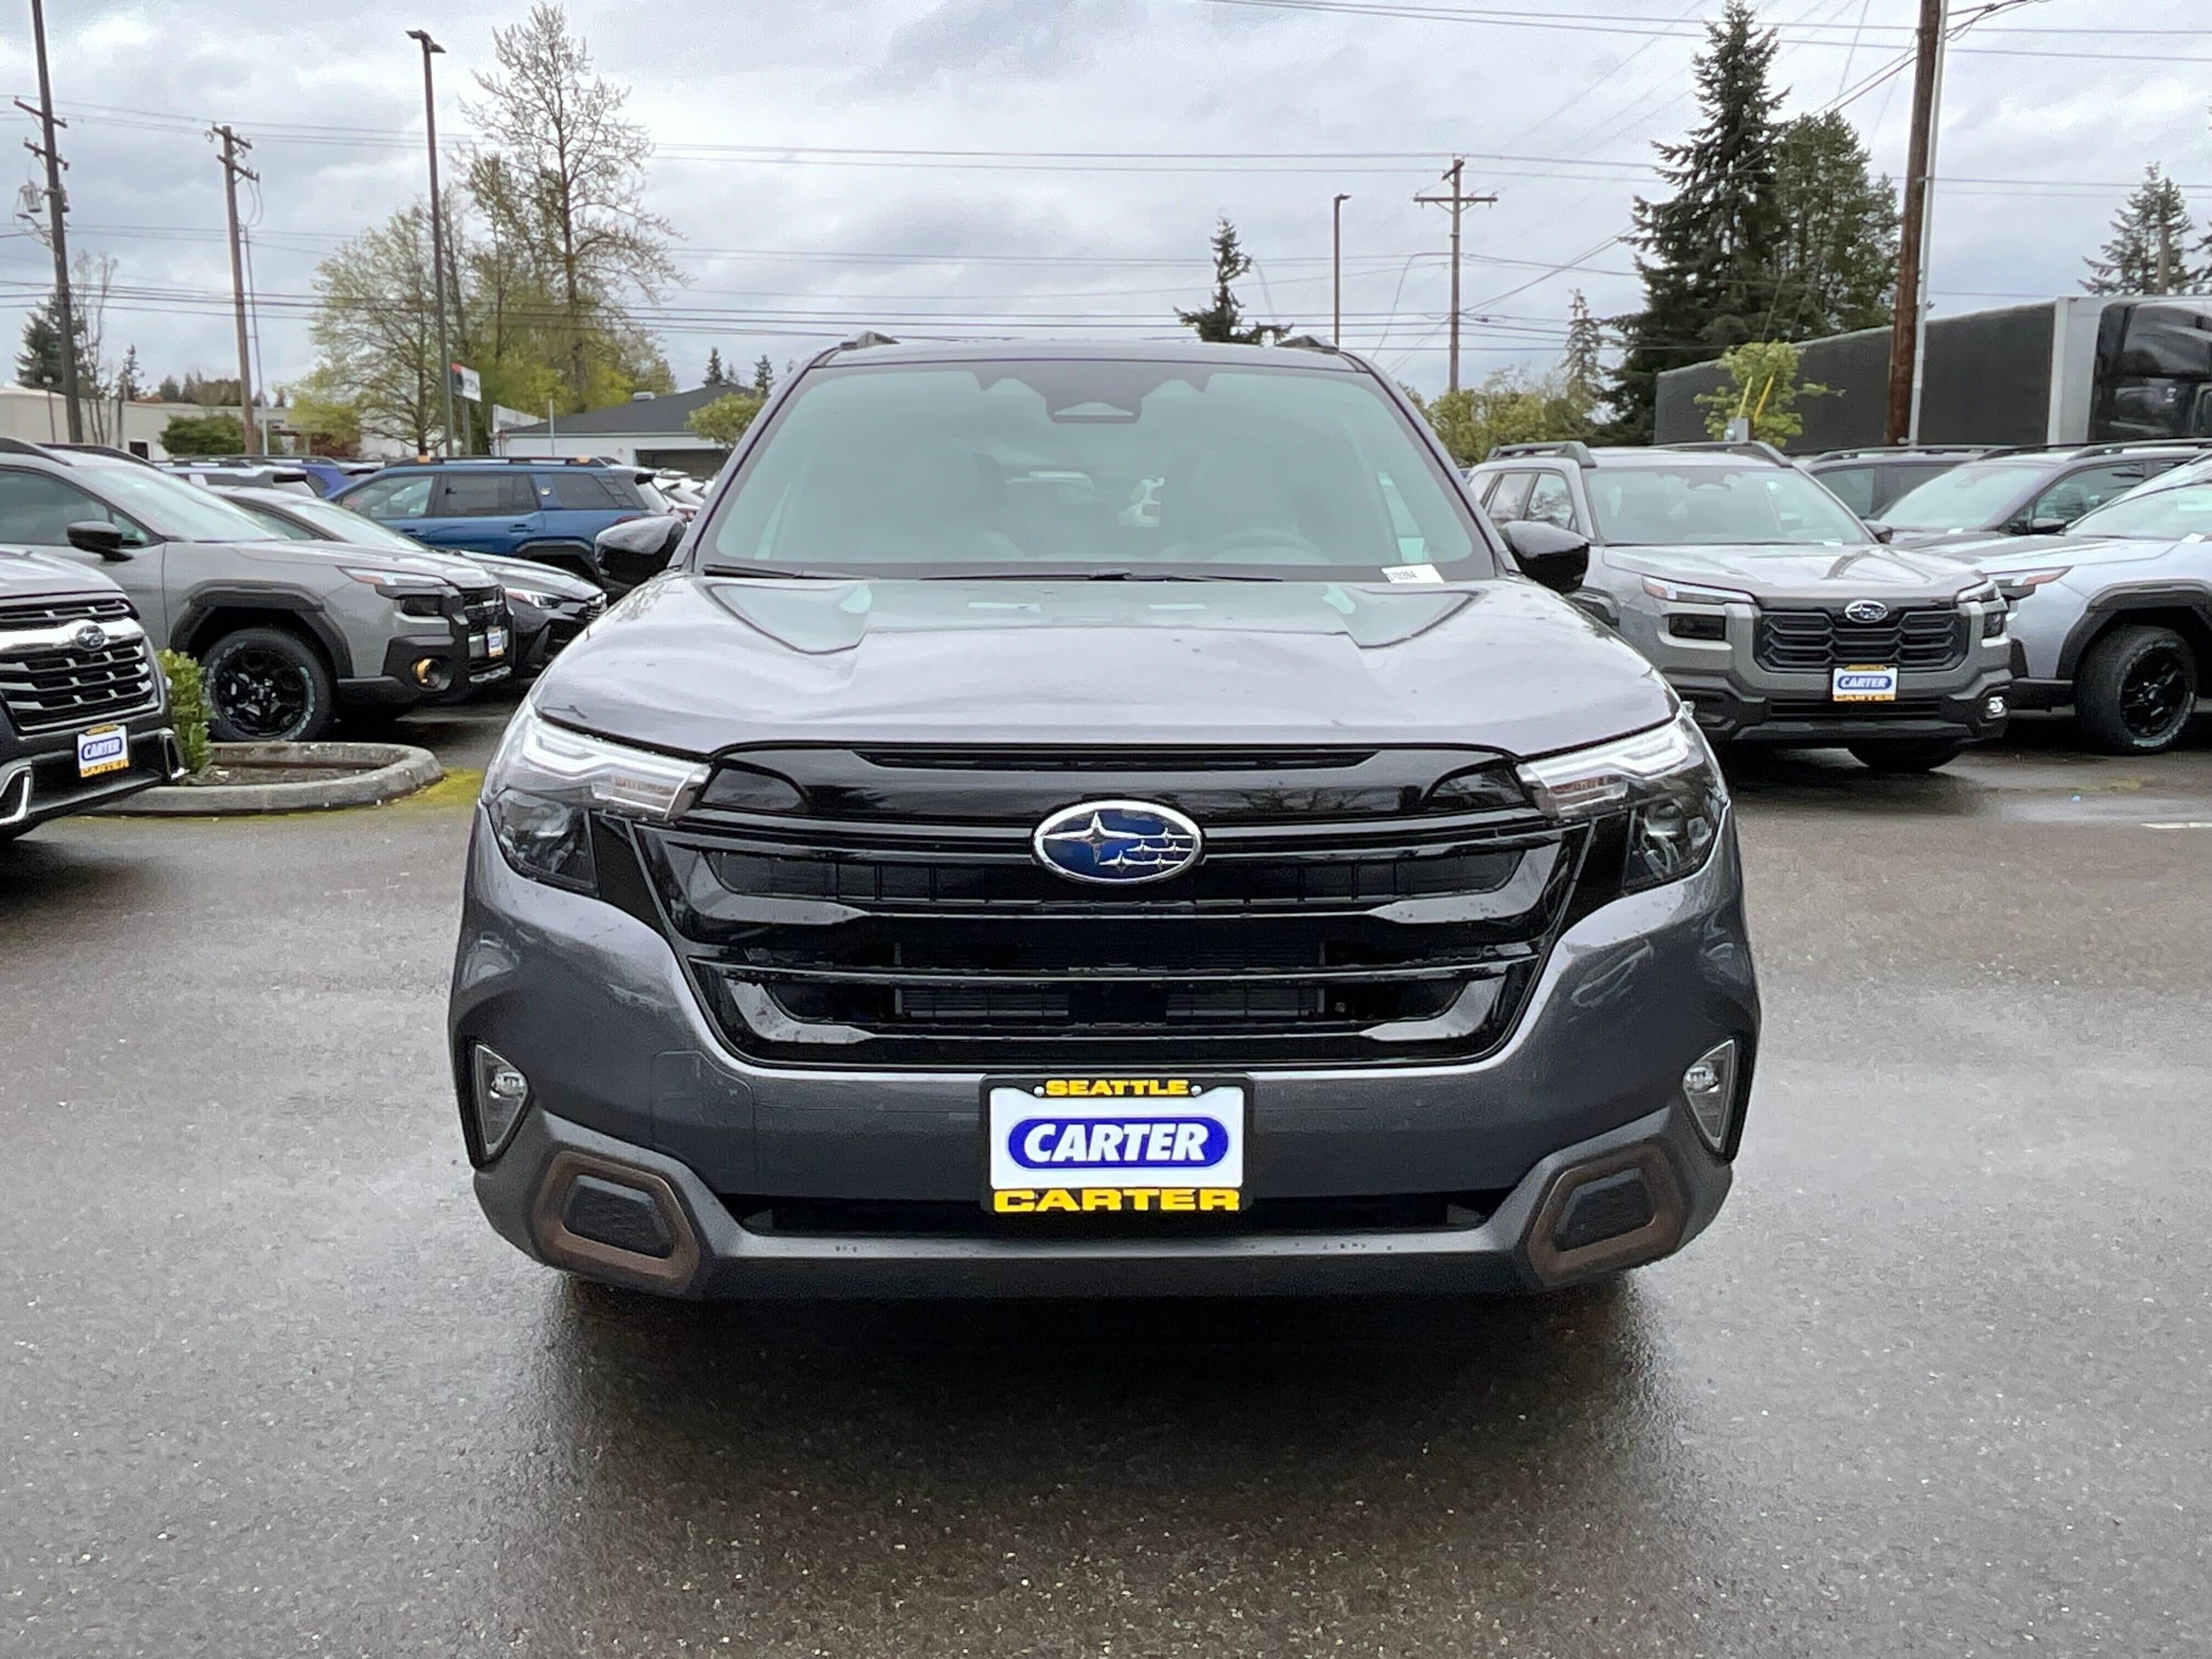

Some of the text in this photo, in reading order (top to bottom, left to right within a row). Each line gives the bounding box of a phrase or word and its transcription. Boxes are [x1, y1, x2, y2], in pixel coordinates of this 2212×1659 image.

[1841, 677, 1888, 687] CARTER
[1046, 1079, 1189, 1096] SEATTLE
[1024, 1122, 1209, 1163] CARTER
[994, 1188, 1240, 1212] CARTER
